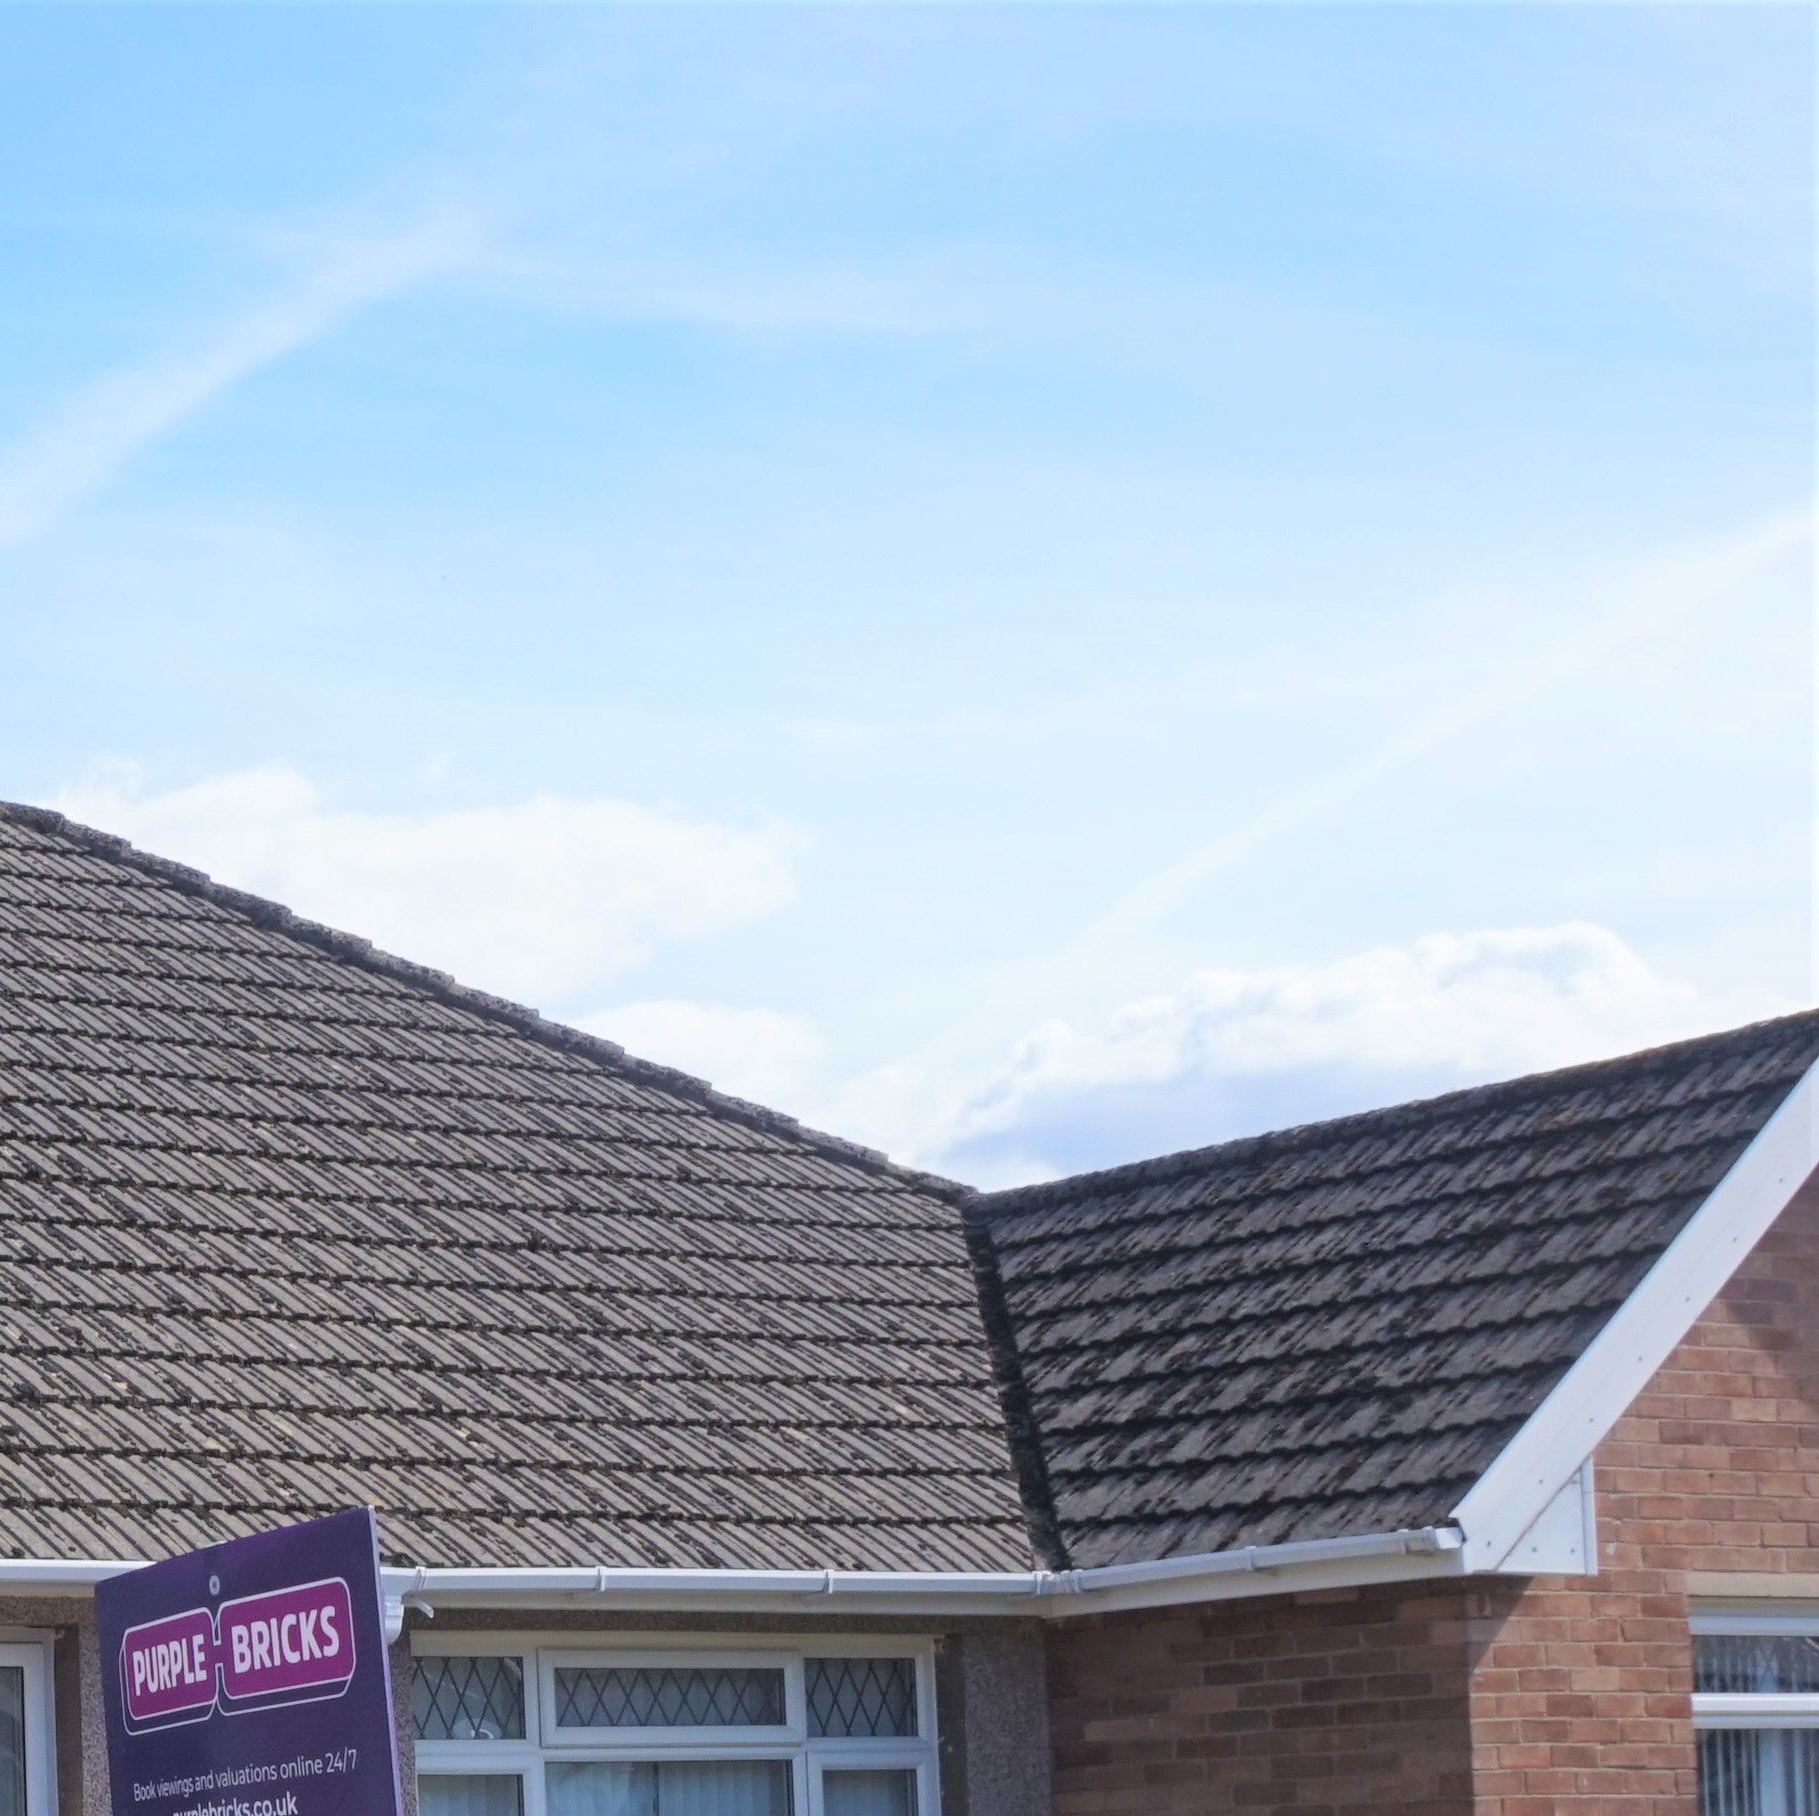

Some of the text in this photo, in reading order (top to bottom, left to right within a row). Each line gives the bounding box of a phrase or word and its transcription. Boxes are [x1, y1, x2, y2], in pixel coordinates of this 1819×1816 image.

[132, 1605, 340, 1697] PURPLE BRICKS
[133, 1746, 357, 1802] Book viewings and valuations online 24/7
